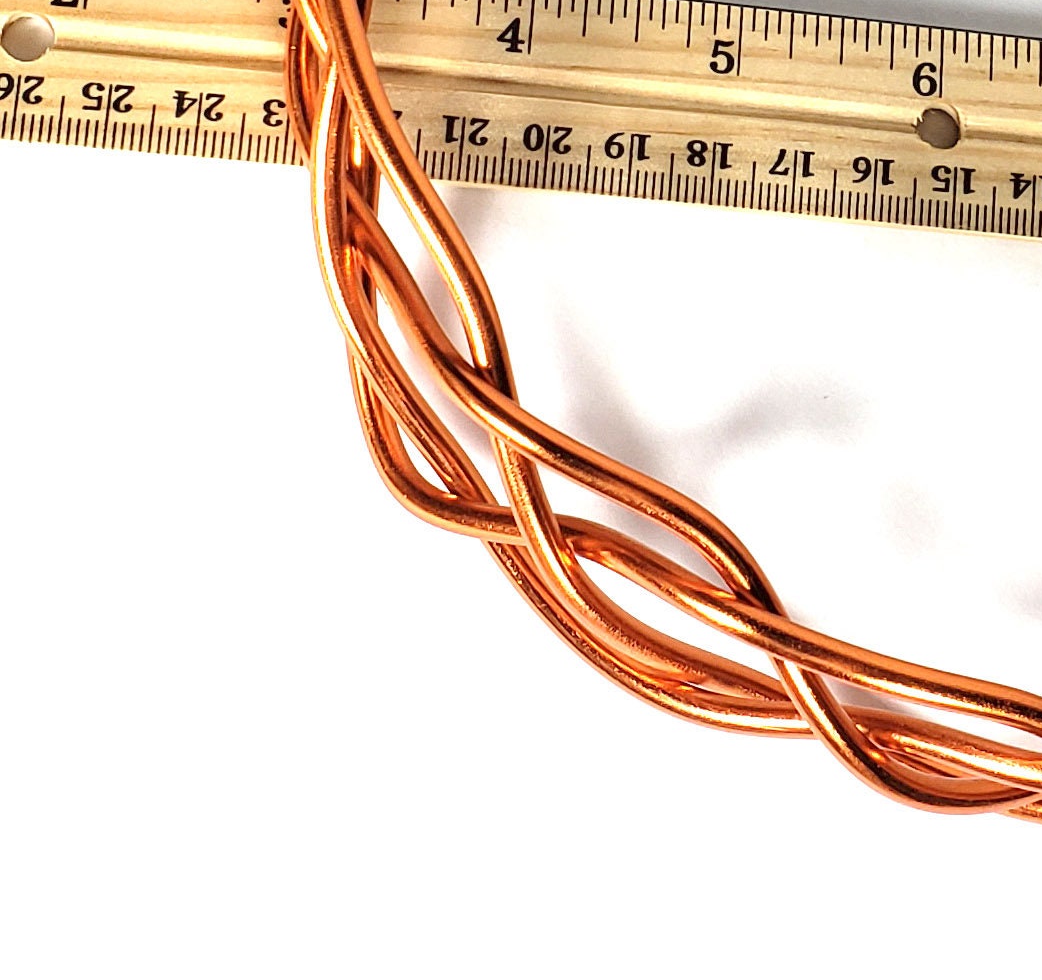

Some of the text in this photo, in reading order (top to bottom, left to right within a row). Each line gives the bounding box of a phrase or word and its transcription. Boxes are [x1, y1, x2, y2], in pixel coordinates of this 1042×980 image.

[497, 18, 524, 52] 4
[710, 40, 734, 73] 5
[913, 63, 937, 96] 6
[82, 82, 135, 112] 25
[173, 90, 225, 121] 24
[442, 115, 489, 146] 21
[523, 124, 572, 154] 20
[605, 133, 651, 160] 19
[687, 140, 733, 169] 18
[769, 149, 815, 177] 17
[852, 156, 895, 185] 16
[931, 165, 976, 194] 15
